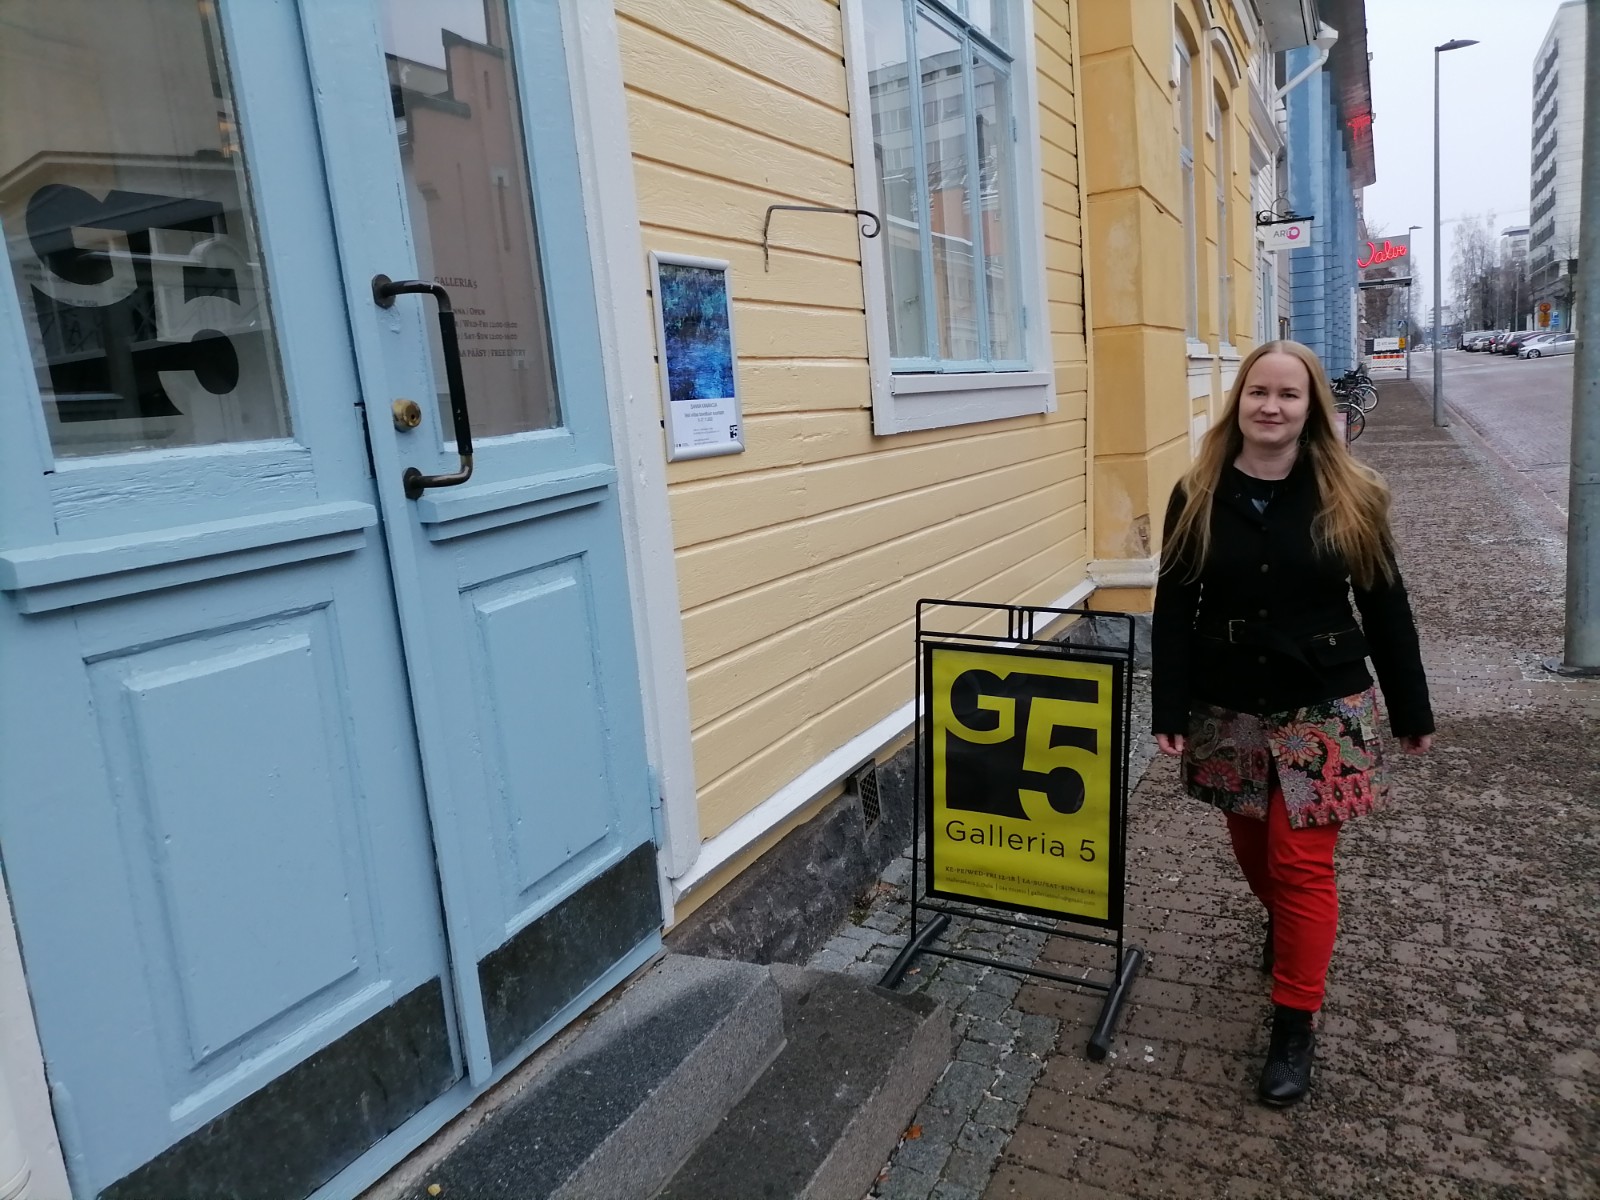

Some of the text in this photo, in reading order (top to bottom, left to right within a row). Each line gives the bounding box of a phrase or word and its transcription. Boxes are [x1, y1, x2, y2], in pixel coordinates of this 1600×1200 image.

[1357, 240, 1407, 268] Valve
[945, 820, 1096, 863] Galleria 5
